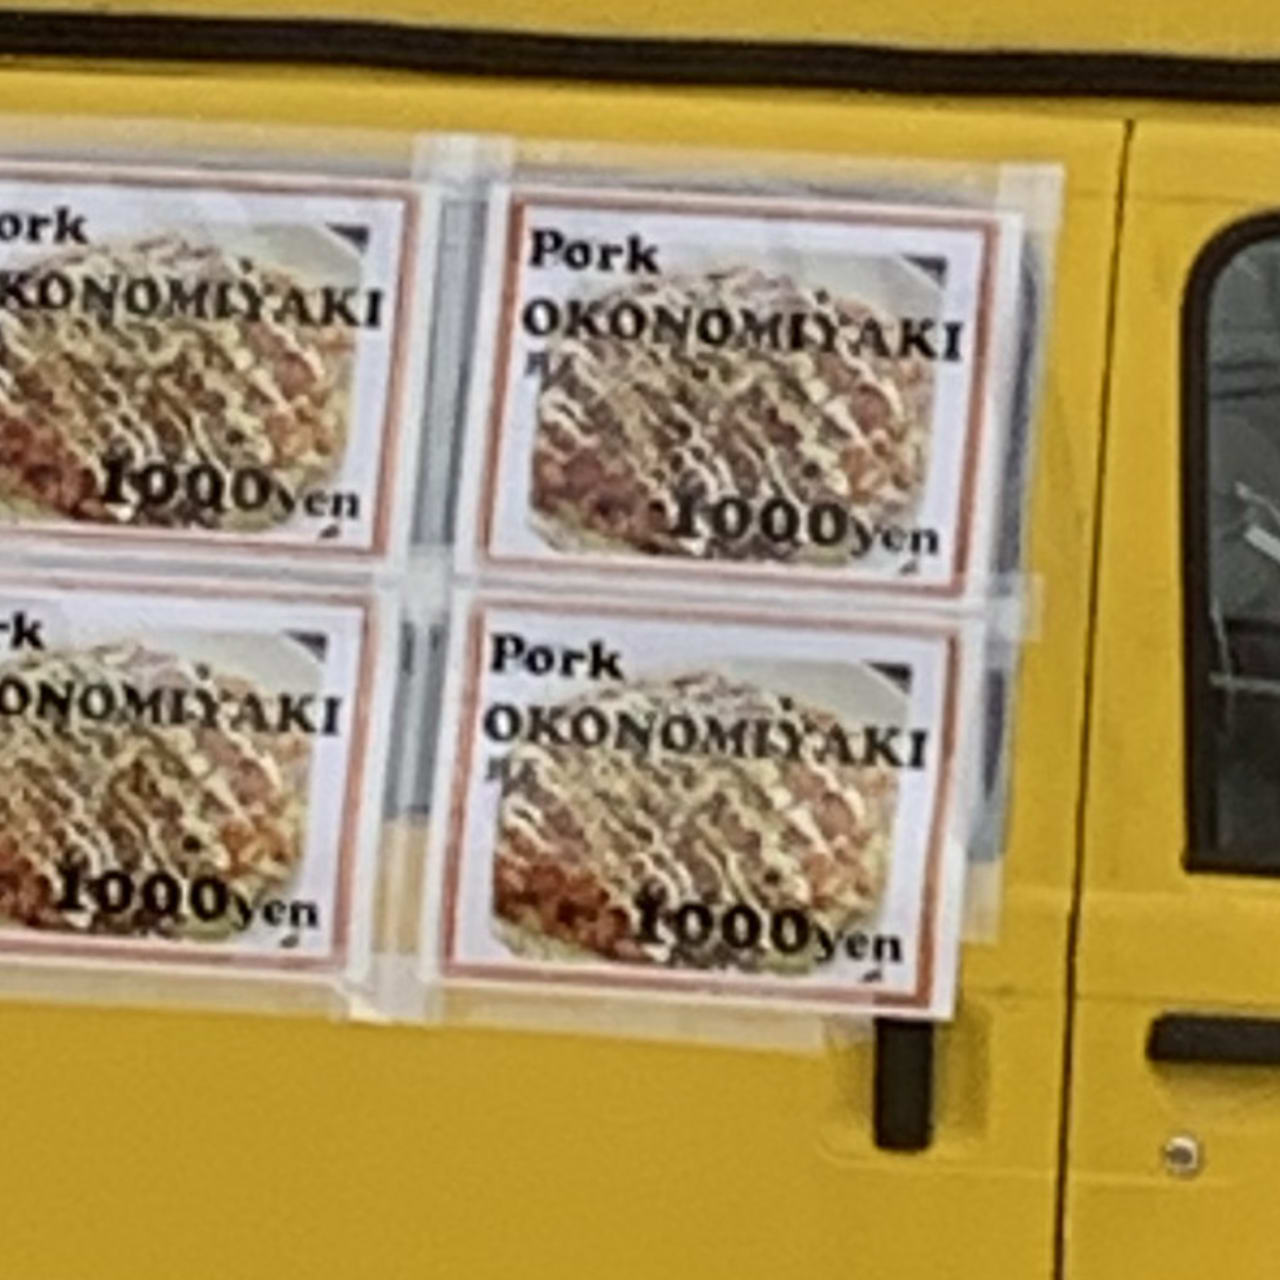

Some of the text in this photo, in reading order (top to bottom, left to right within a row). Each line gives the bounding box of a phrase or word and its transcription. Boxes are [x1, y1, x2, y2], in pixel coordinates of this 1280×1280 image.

[529, 228, 661, 275] Pork
[522, 298, 965, 363] OKONOMIYAKI
[489, 634, 626, 680] Pork
[482, 703, 929, 771] OKONOMIYAKI
